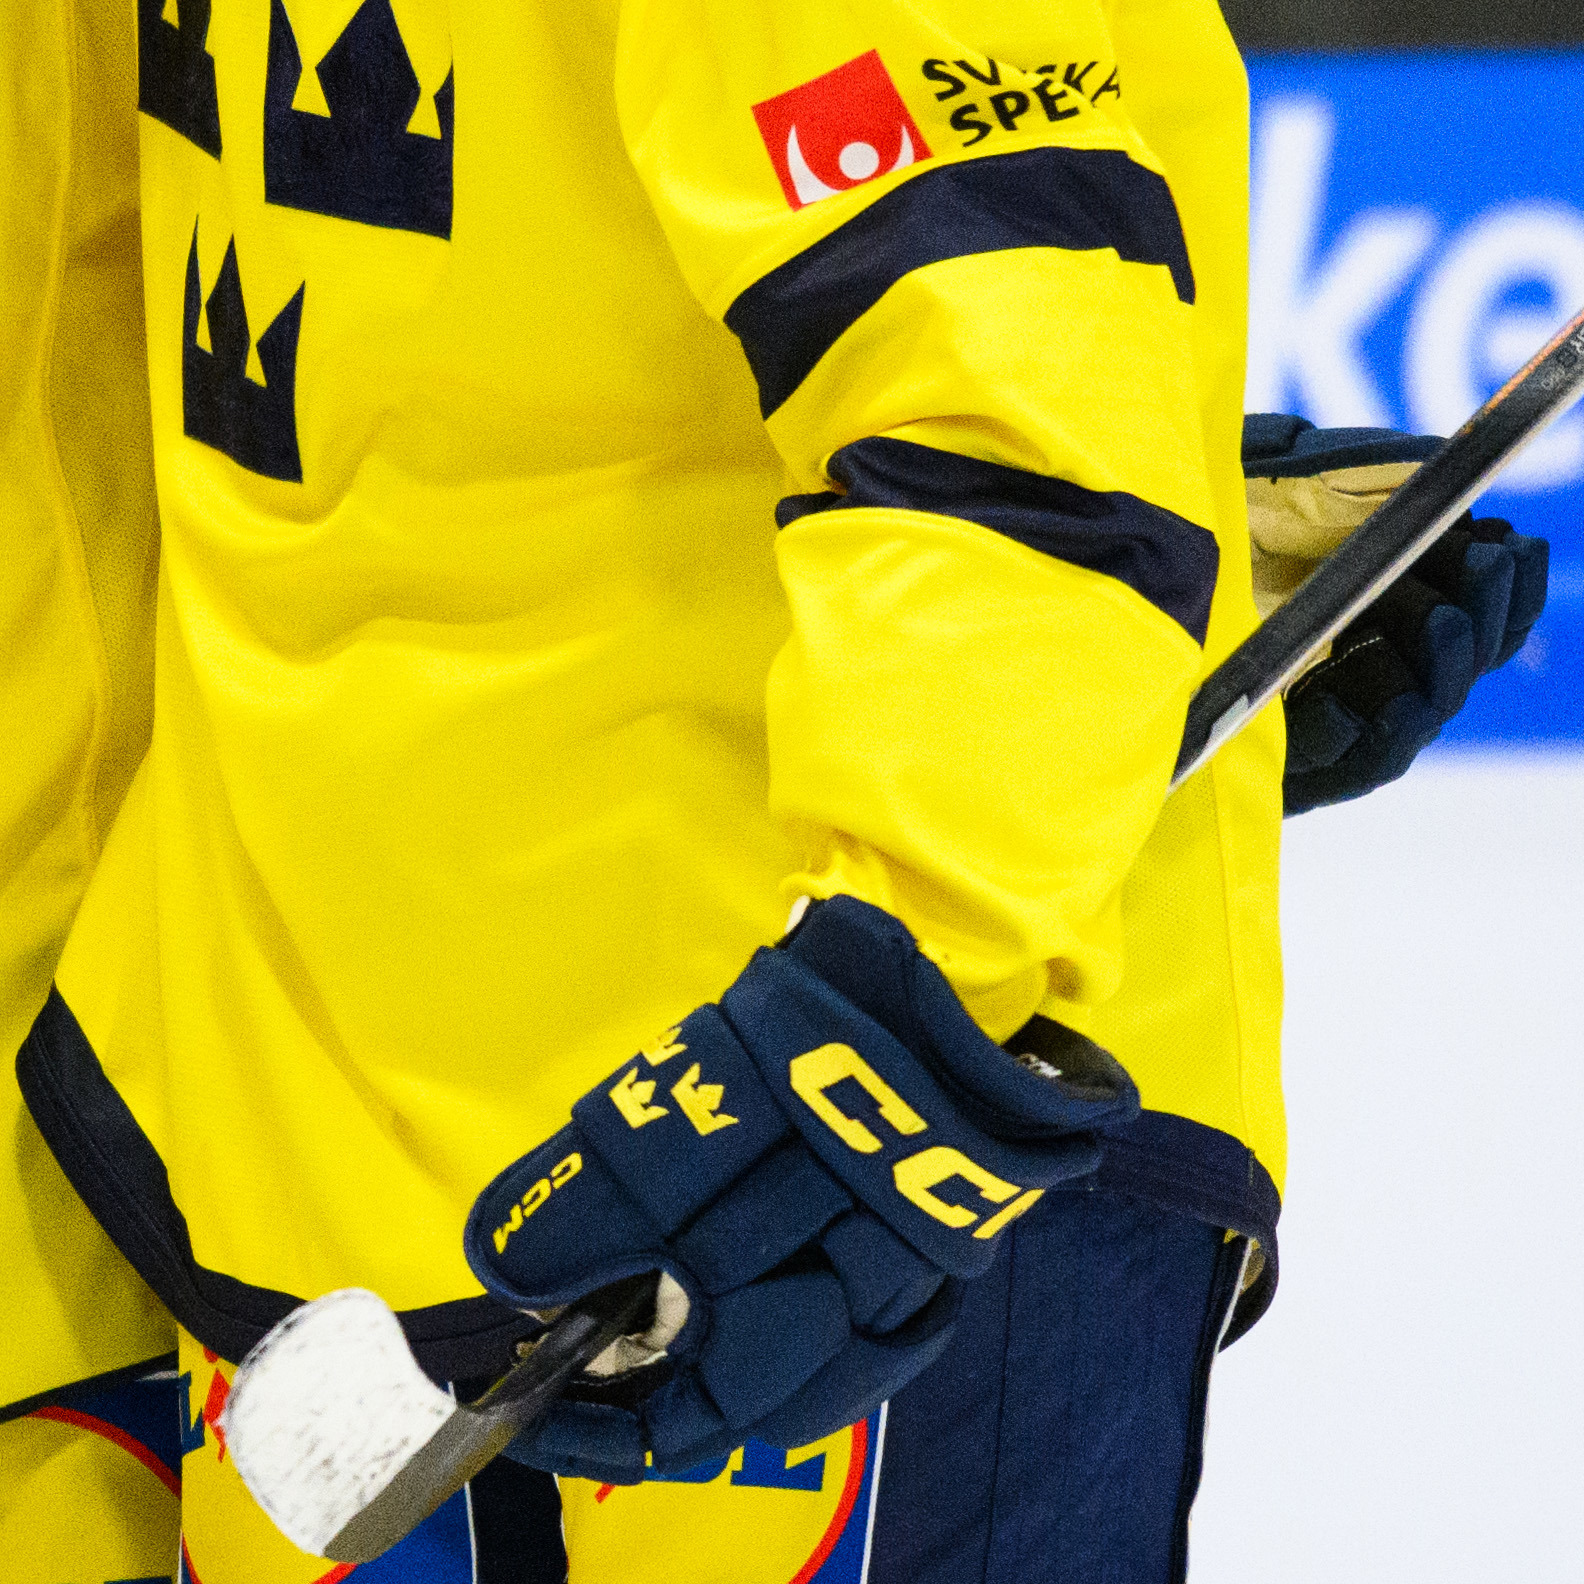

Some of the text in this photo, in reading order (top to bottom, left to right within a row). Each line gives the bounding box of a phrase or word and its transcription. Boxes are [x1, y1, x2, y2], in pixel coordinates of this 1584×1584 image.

[949, 77, 1082, 148] SPE
[789, 1042, 1045, 1240] CC
[493, 1151, 583, 1255] CCM
